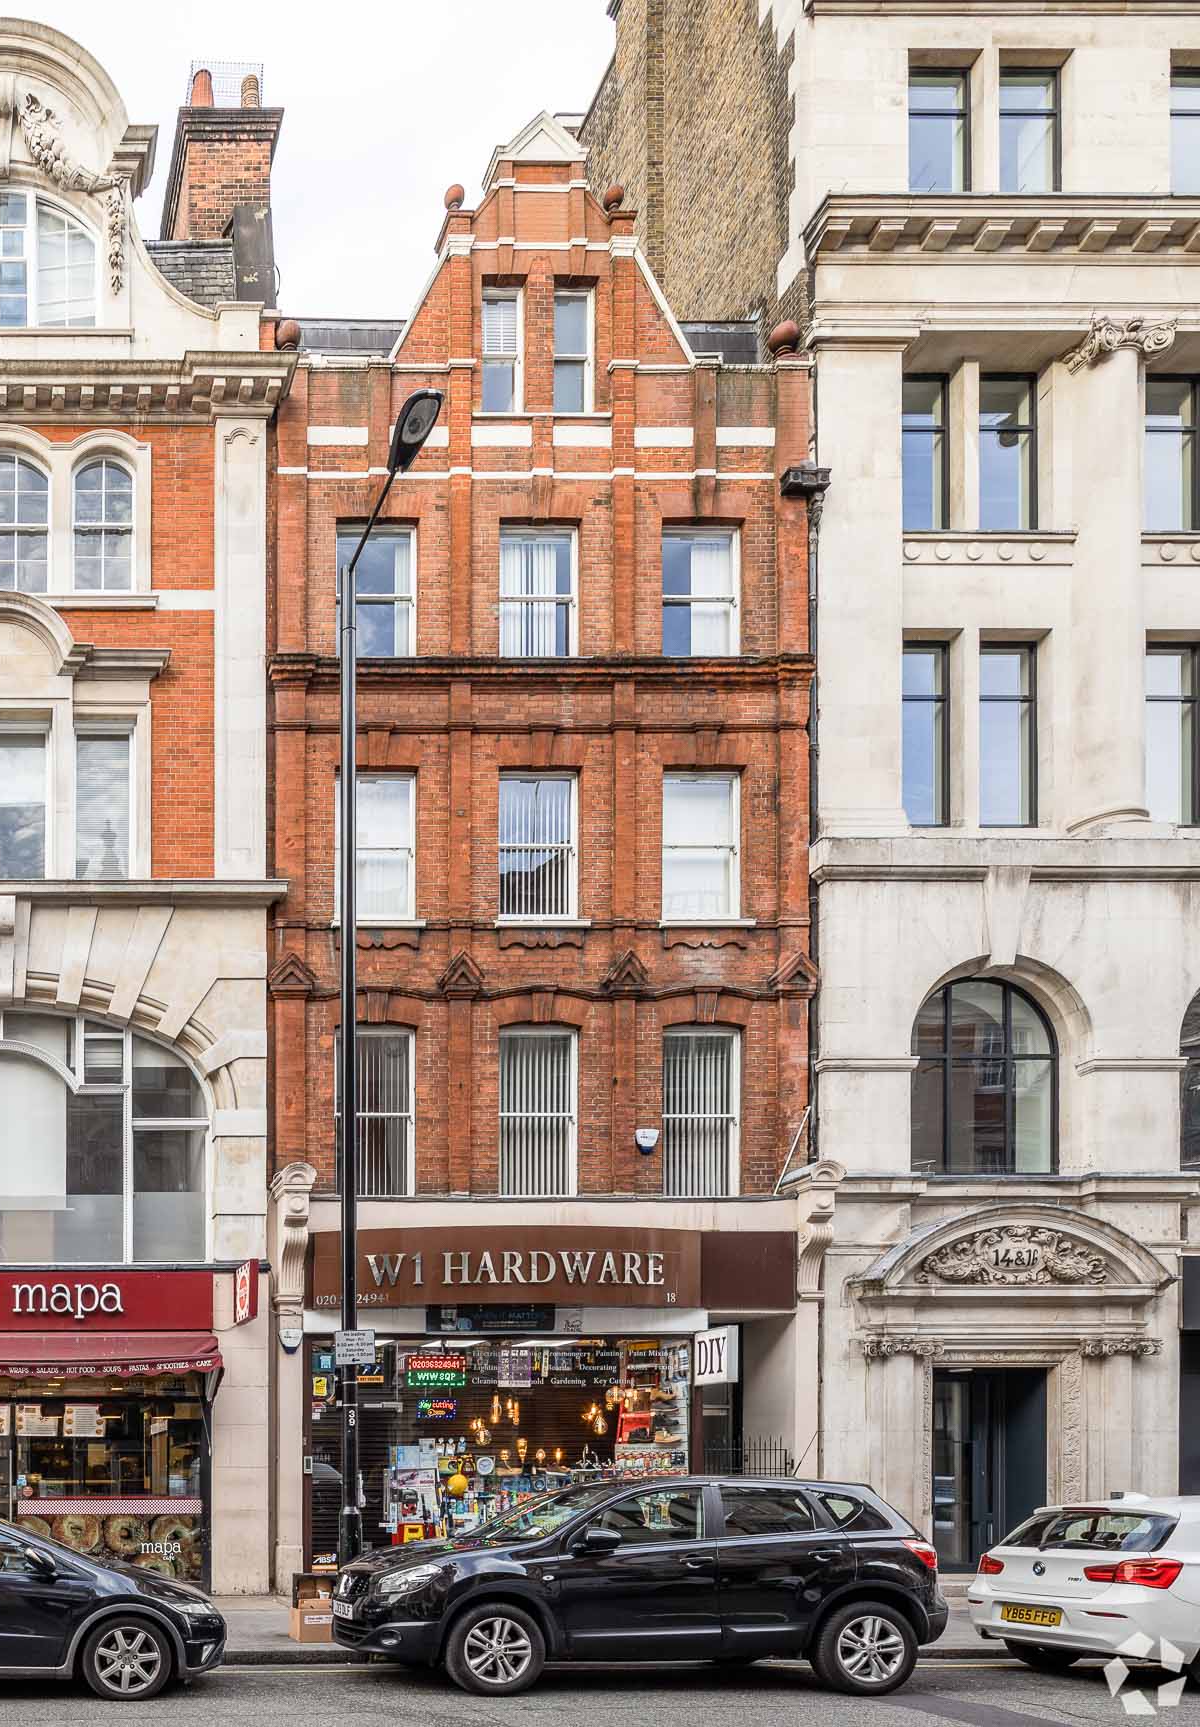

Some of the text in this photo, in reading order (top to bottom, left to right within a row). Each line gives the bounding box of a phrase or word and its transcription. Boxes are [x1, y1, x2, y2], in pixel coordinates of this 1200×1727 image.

[364, 1250, 666, 1286] W1 HARDWARE
[12, 1283, 124, 1319] mapa
[666, 1292, 676, 1303] 18
[697, 1336, 726, 1376] DIY
[79, 1366, 96, 1374] FOOD
[128, 1364, 150, 1372] PASTAS
[579, 1363, 617, 1374] Decorating
[471, 1376, 498, 1385] Cleanin
[550, 1376, 587, 1387] Gardening
[593, 1376, 608, 1388] Key
[140, 1541, 182, 1556] mapa
[1006, 1607, 1057, 1624] YB65 FFG
